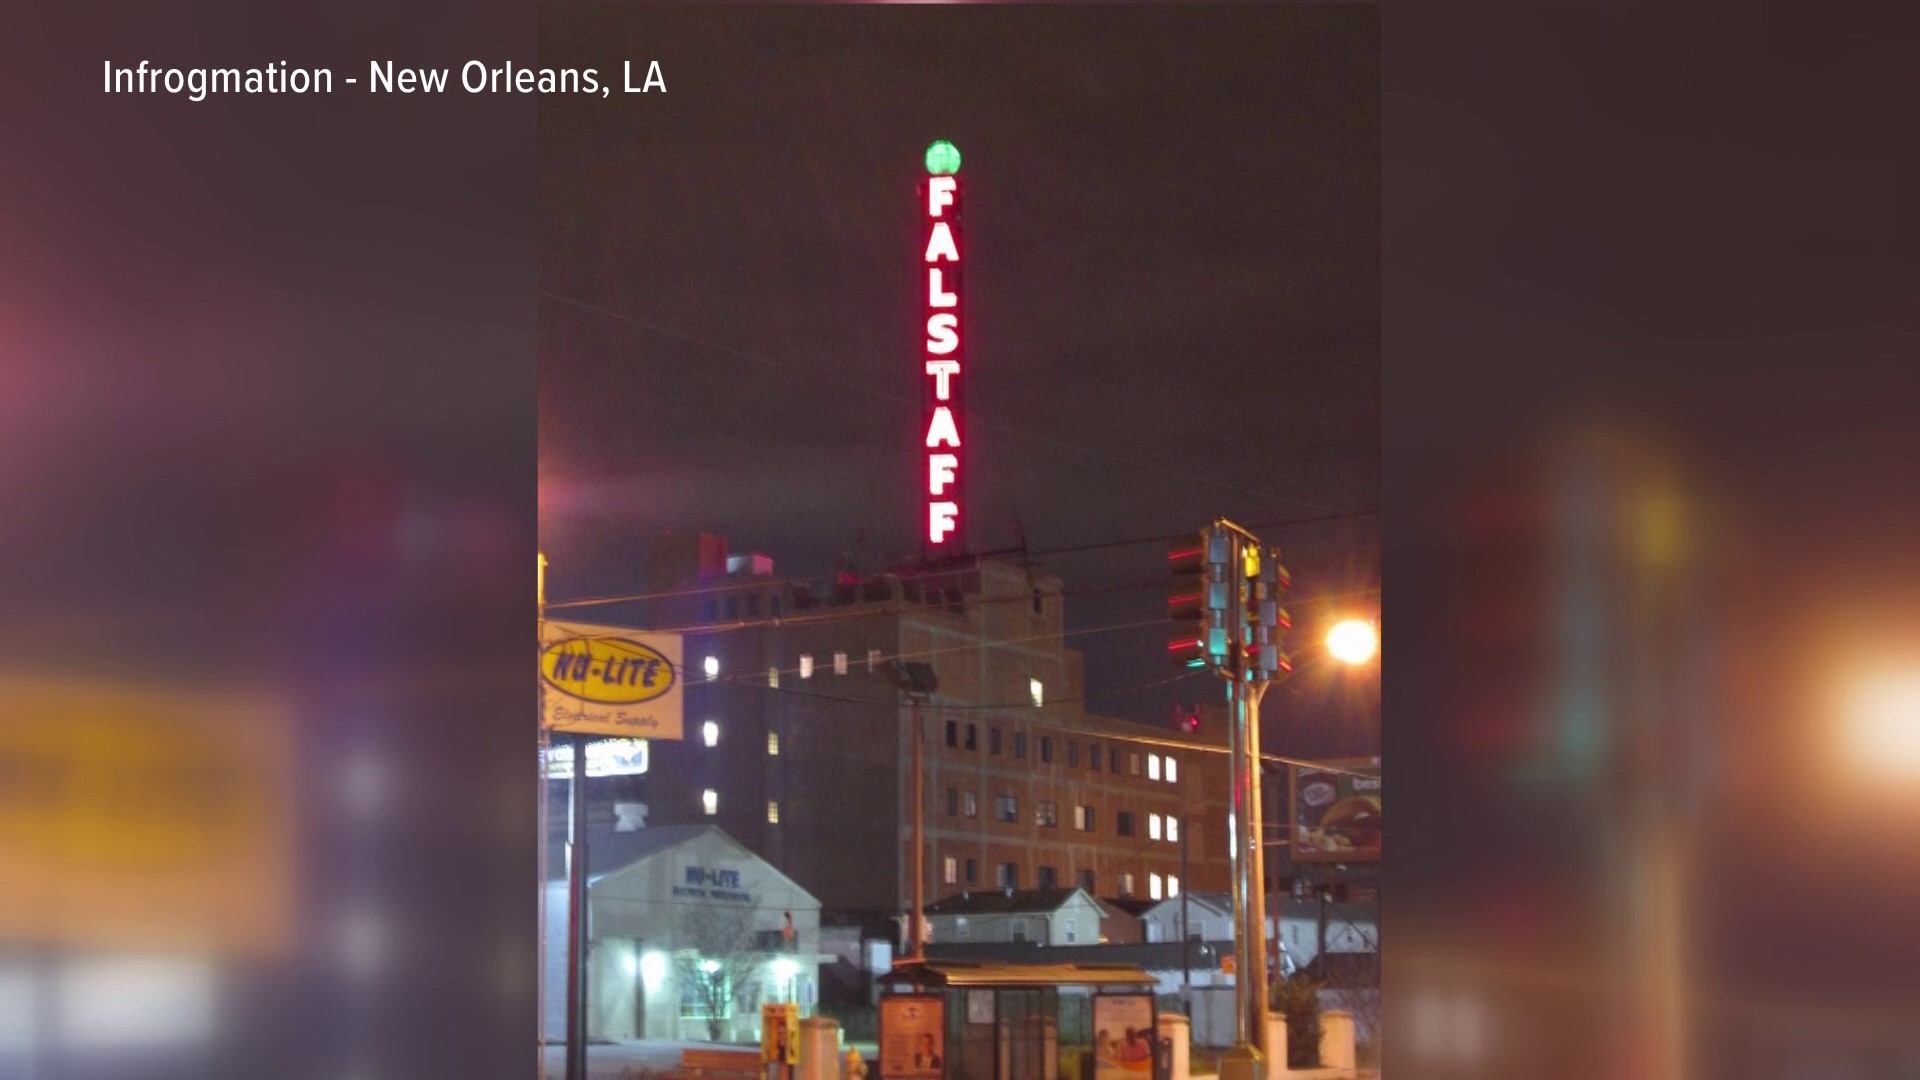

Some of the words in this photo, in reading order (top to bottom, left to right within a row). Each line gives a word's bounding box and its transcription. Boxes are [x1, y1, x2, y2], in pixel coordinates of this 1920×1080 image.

[925, 176, 961, 543] FALSTAFF
[553, 653, 661, 687] NU-LITE
[615, 712, 659, 729] Supply
